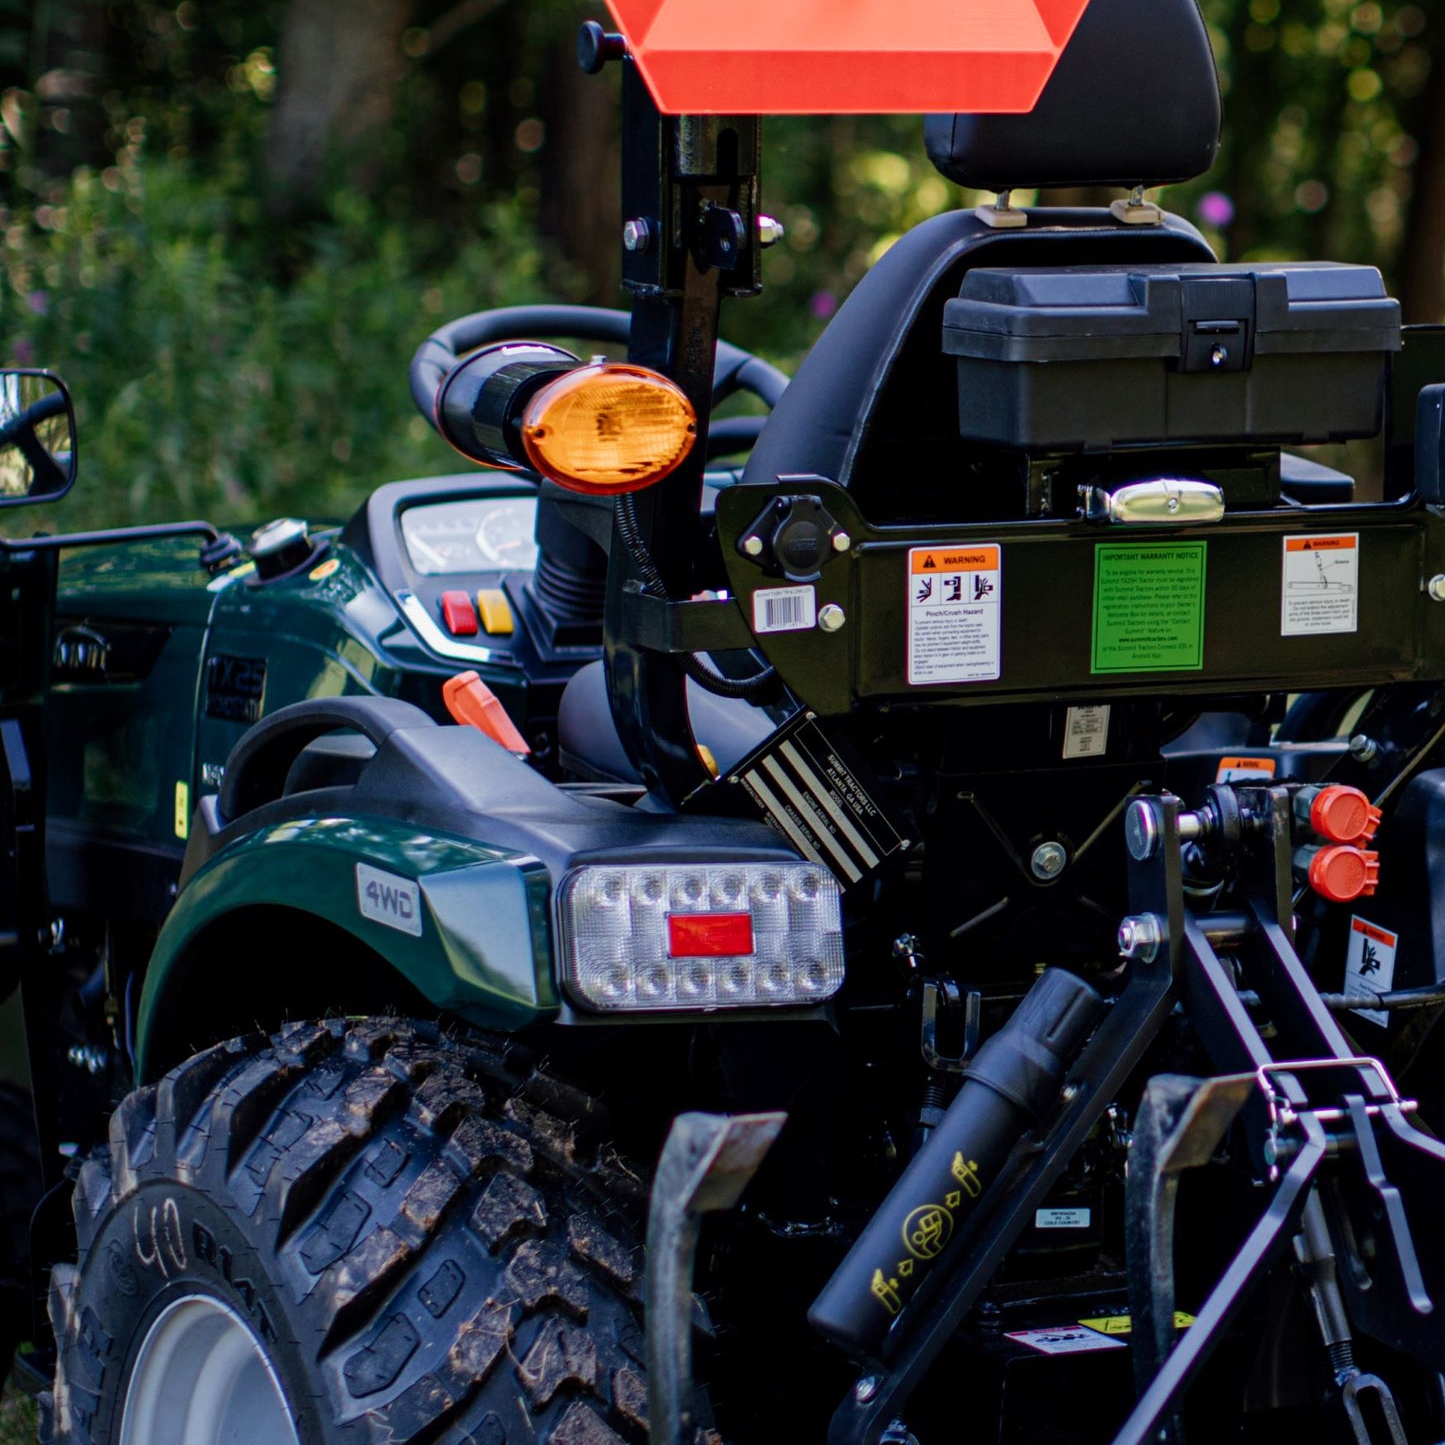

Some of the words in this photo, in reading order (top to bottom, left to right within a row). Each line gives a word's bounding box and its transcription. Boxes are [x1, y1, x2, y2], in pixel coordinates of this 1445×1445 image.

[944, 555, 986, 565] WARNING
[1103, 553, 1138, 561] IMPORTANT
[1140, 552, 1175, 560] WARRANTY
[1176, 552, 1199, 560] NOTICE
[926, 609, 962, 617] Pinch/Crush
[827, 754, 847, 777] SUMMIT
[844, 775, 868, 806] TRACTORS
[865, 803, 877, 816] LLC
[846, 793, 856, 803] GA
[852, 801, 864, 815] USA
[366, 880, 413, 919] 4WD
